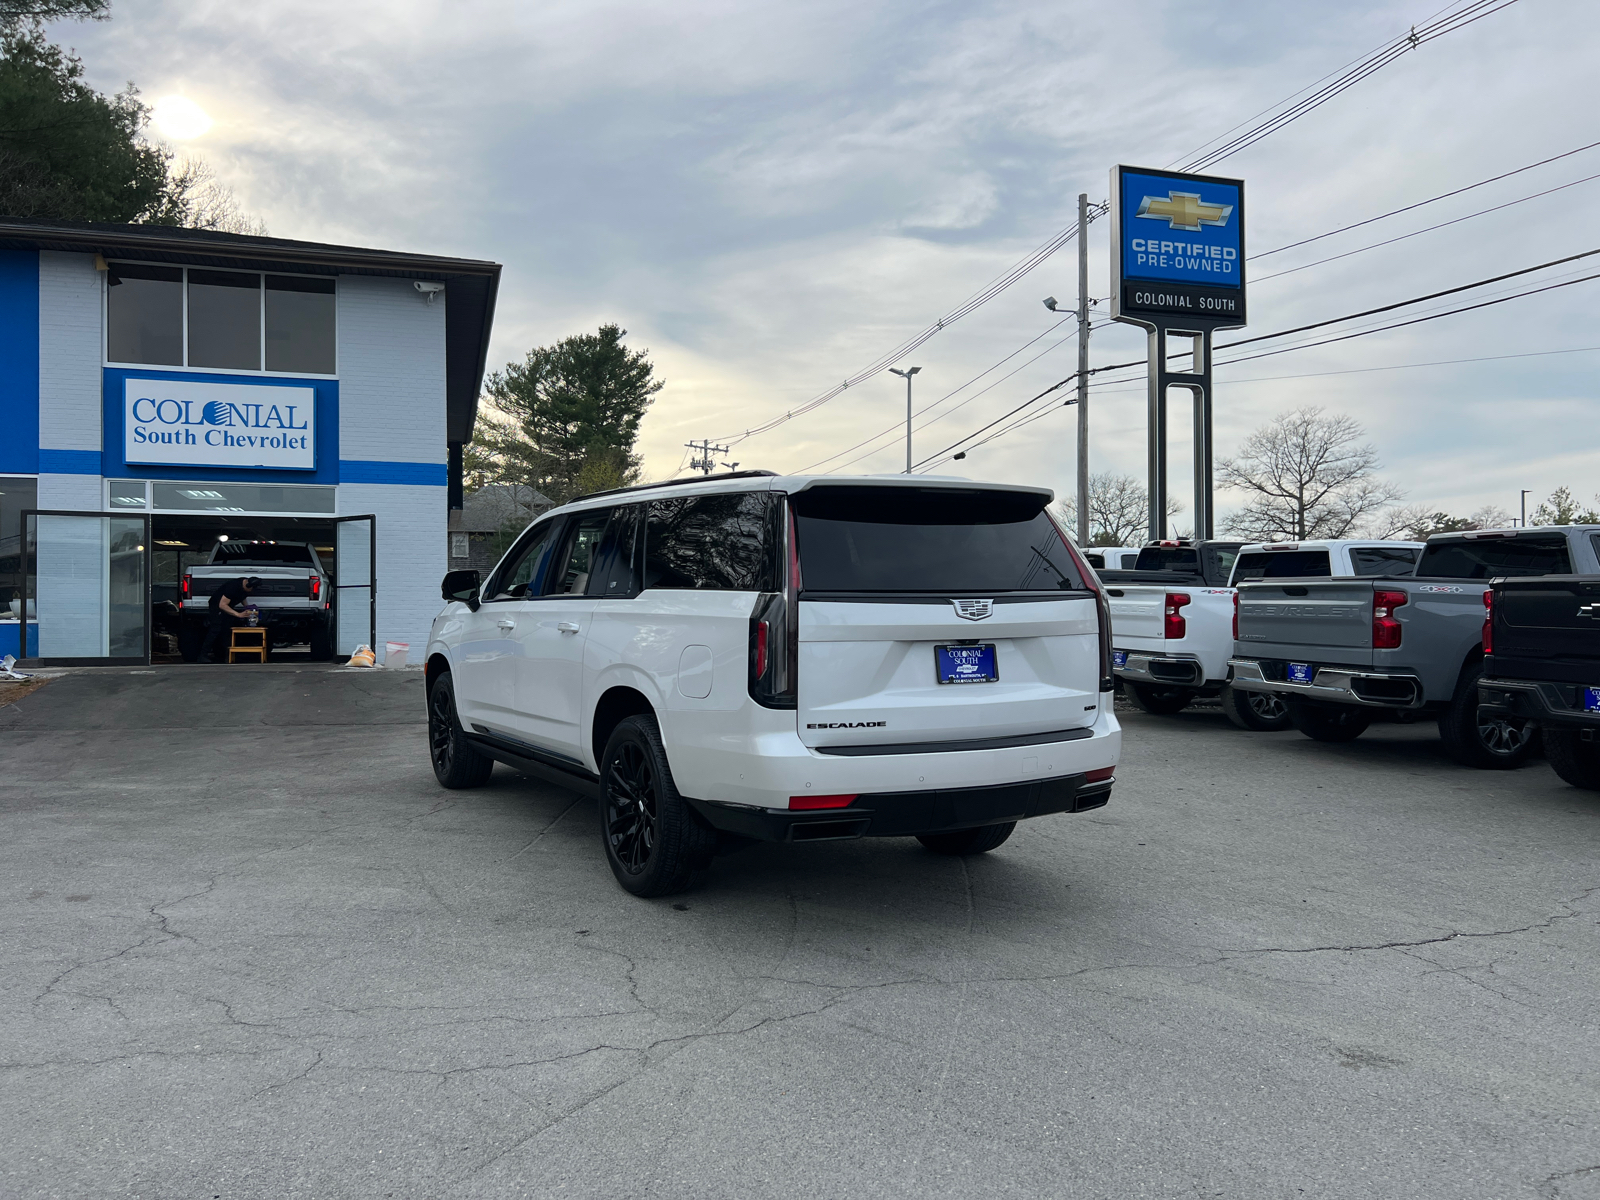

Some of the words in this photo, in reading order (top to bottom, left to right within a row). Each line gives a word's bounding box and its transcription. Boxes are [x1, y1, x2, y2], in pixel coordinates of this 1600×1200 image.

[1132, 239, 1236, 260] CERTIFIED
[1137, 253, 1232, 273] PRE-OWNED
[1135, 292, 1193, 308] COLONIAL
[1199, 297, 1235, 311] SOUTH
[132, 397, 308, 430] COLONIAL
[133, 426, 197, 446] South
[204, 429, 308, 450] Chevrolet
[1242, 606, 1360, 618] CHEVROLET
[954, 657, 979, 665] SOUTH
[807, 720, 887, 730] ESCALADE
